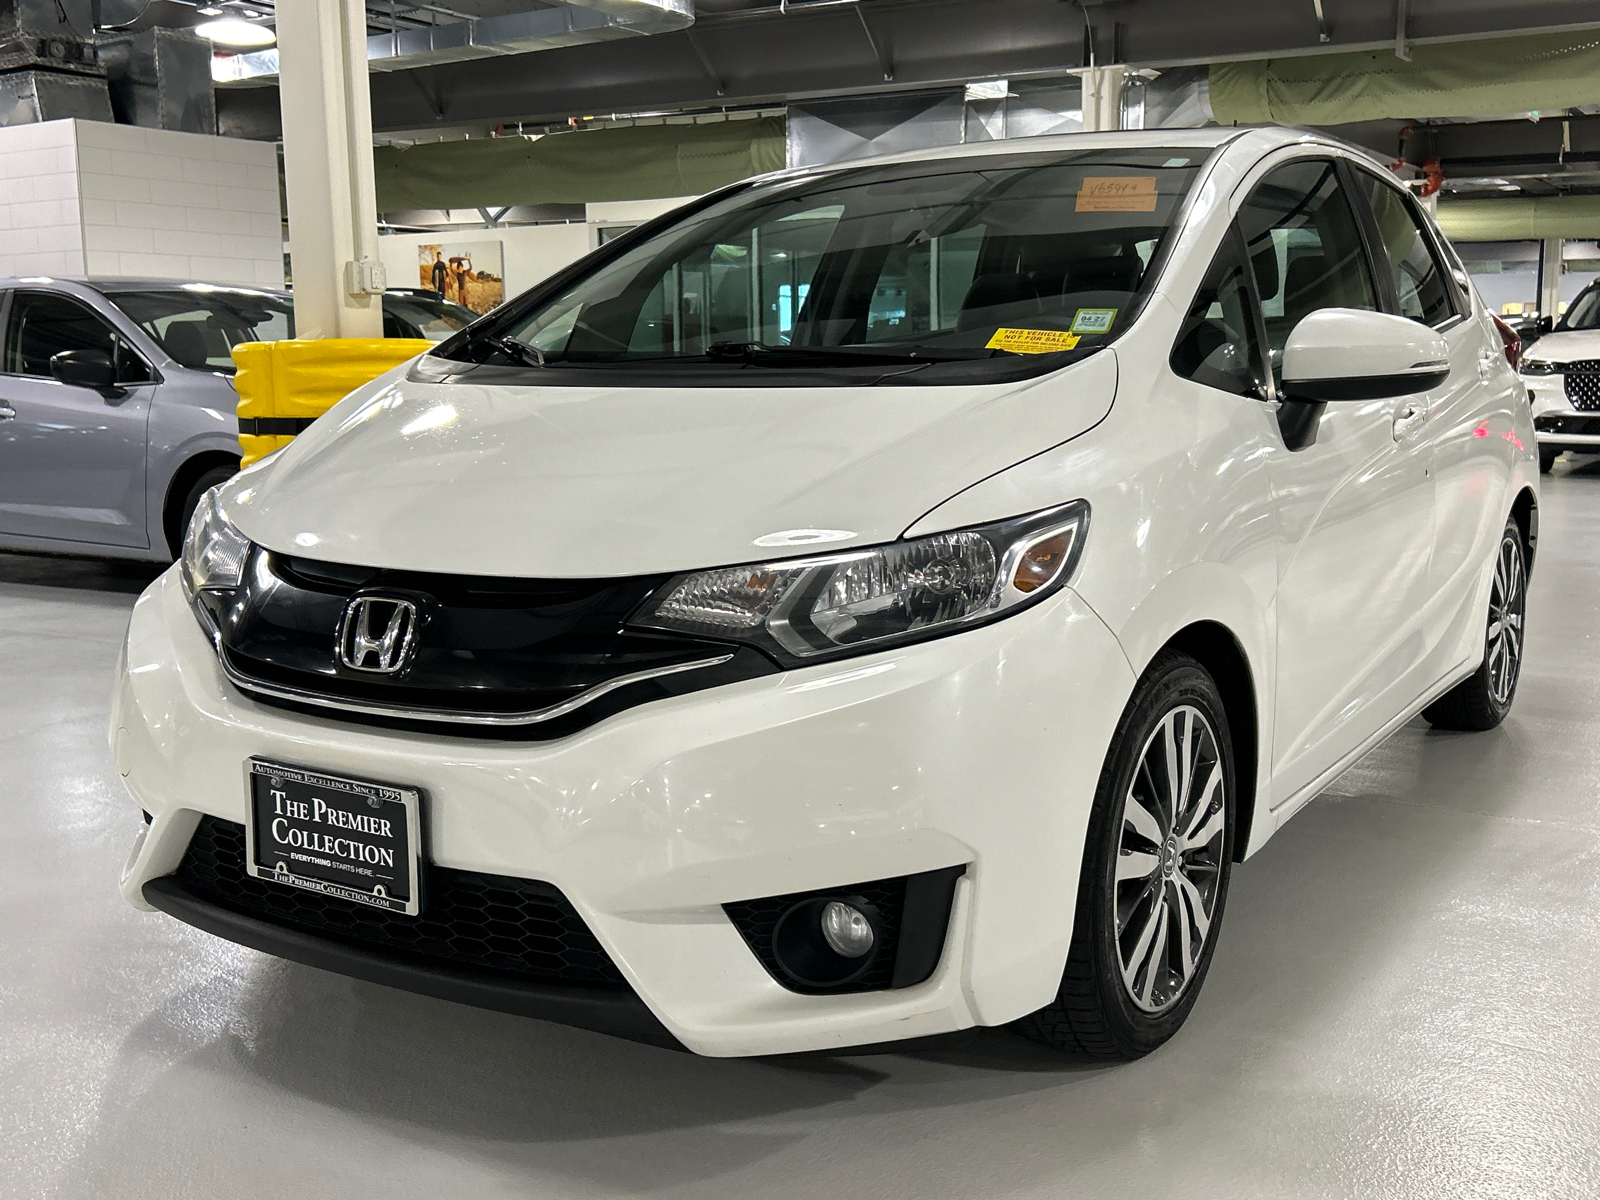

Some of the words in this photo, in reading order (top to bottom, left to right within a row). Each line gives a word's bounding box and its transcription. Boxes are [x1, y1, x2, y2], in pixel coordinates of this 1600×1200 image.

[1027, 330, 1064, 338] VEHICLE
[254, 764, 304, 781] AUTOMOTIVE
[303, 773, 351, 791] EXCELLENCE
[352, 783, 376, 796] SINCE
[379, 788, 401, 801] 1995
[270, 789, 310, 820] THE
[311, 797, 394, 838] PREMIER
[271, 817, 395, 868] COLLECTION
[290, 852, 332, 867] EVERYTHING
[331, 860, 355, 873] STARTS
[355, 866, 375, 878] HERE.
